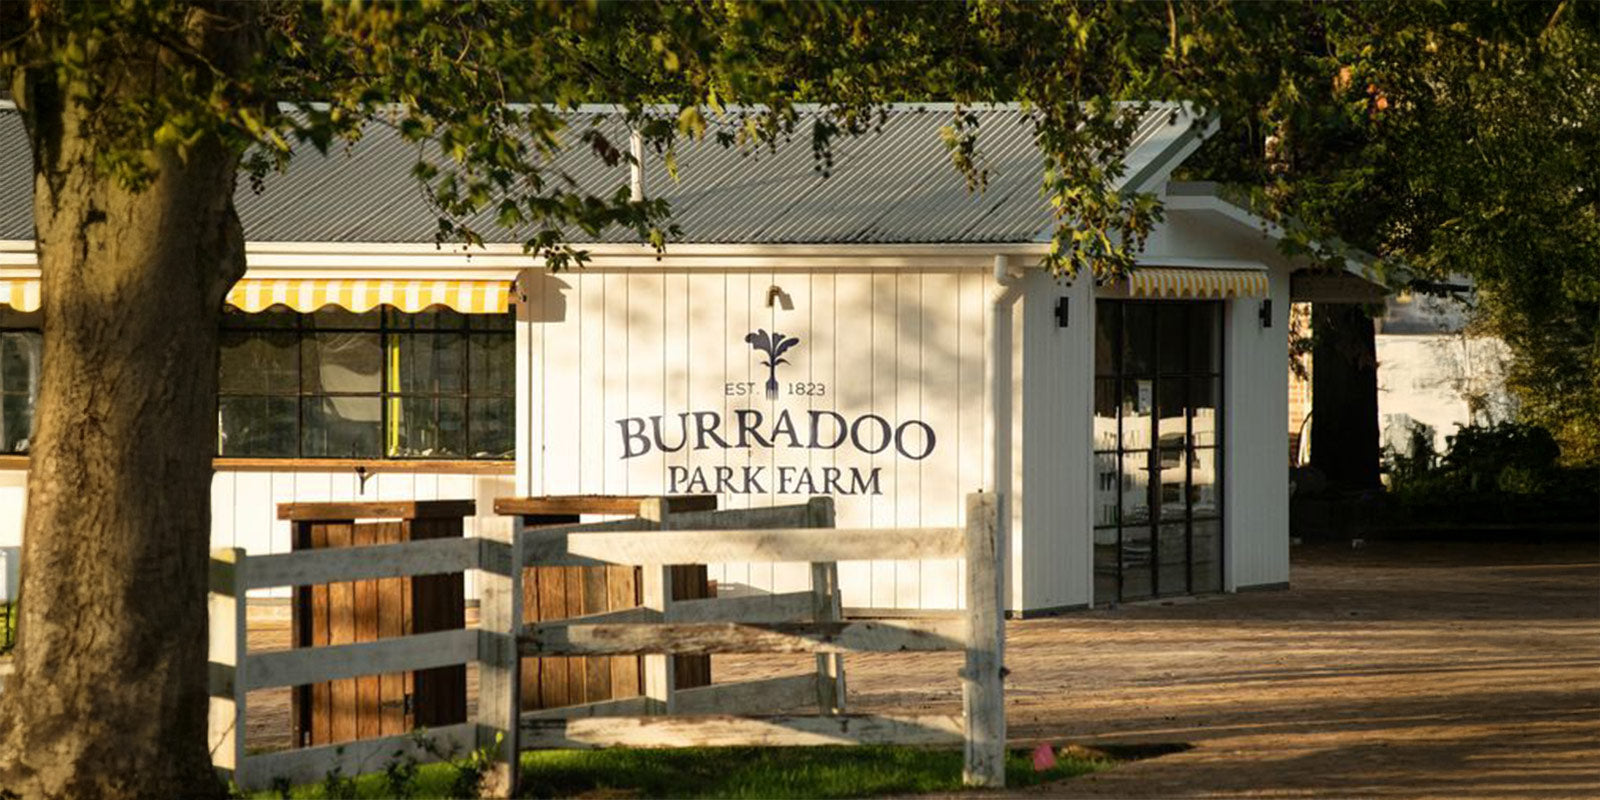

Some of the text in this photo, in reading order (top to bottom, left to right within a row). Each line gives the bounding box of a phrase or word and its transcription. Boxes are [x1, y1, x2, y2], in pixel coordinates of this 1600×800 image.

[724, 382, 826, 397] EST. 1823
[615, 408, 937, 461] BURRADOO
[668, 465, 883, 496] PARK FARM
